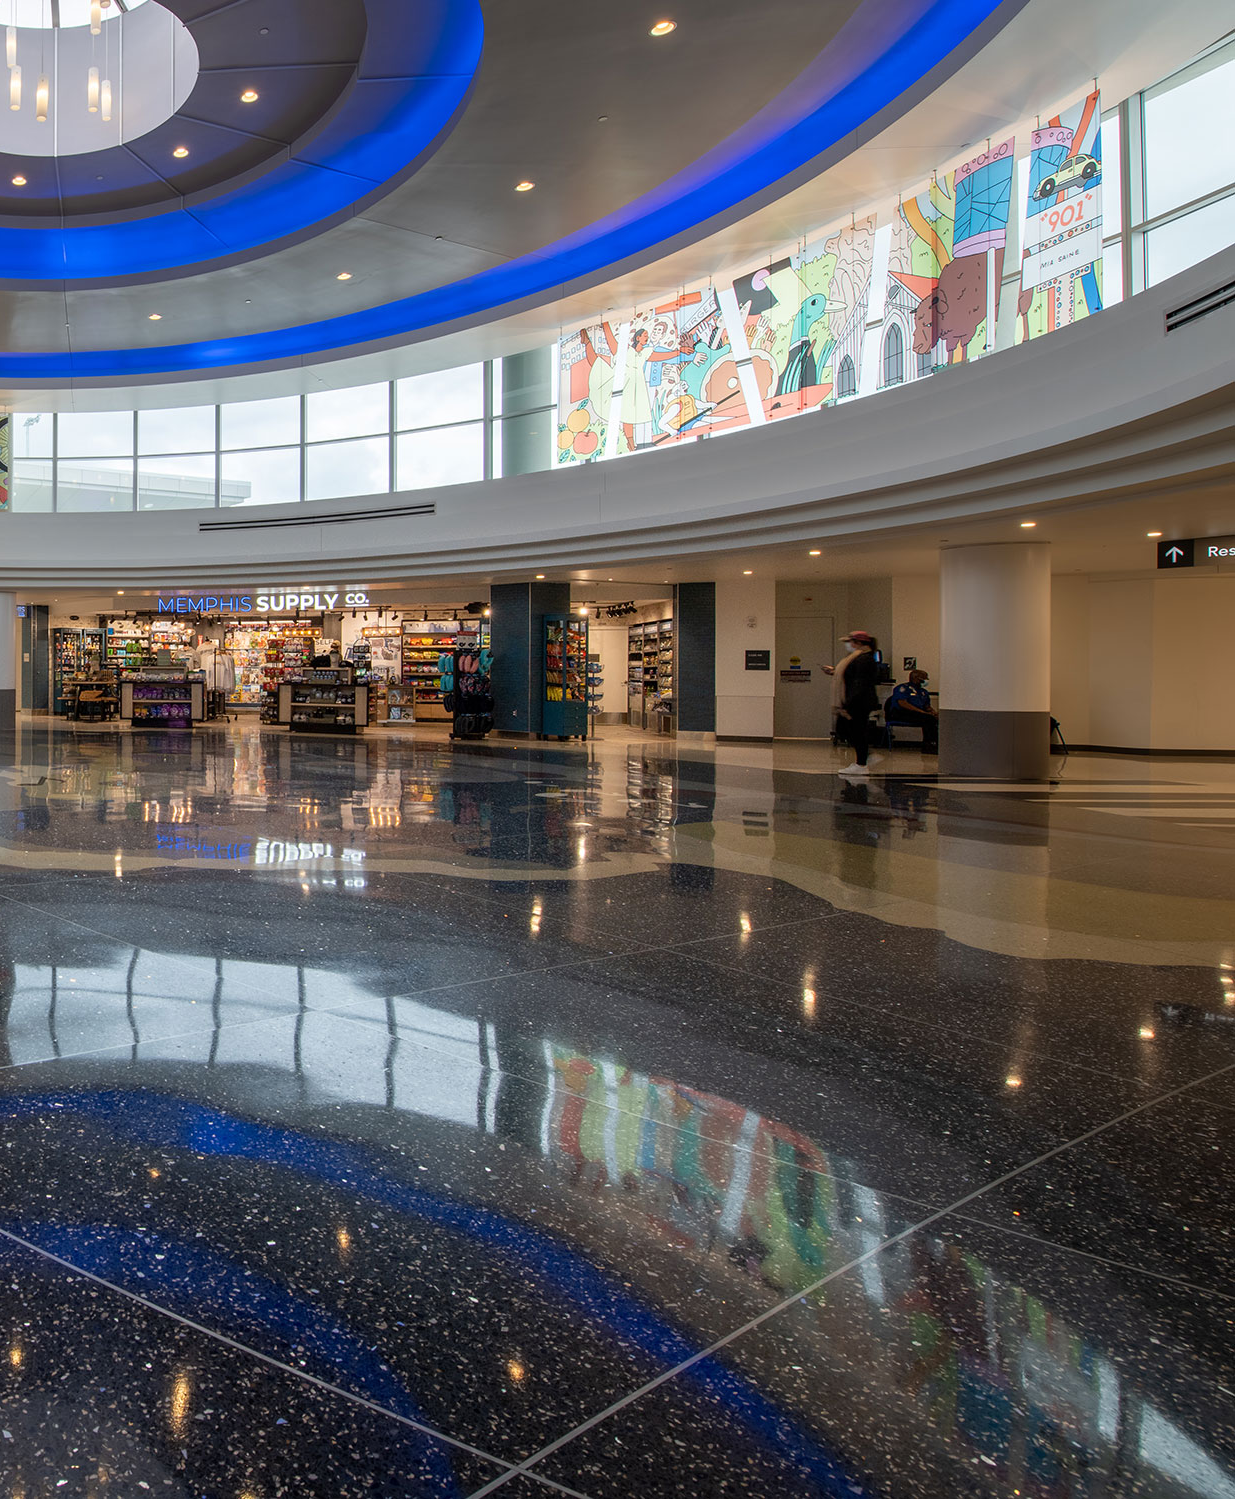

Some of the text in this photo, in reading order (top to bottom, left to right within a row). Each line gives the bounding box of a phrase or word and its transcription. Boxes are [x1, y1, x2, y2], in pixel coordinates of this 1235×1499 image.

[1040, 249, 1080, 269] MIA SAINE
[158, 593, 370, 613] MEMPHIS SUPPLY CO.
